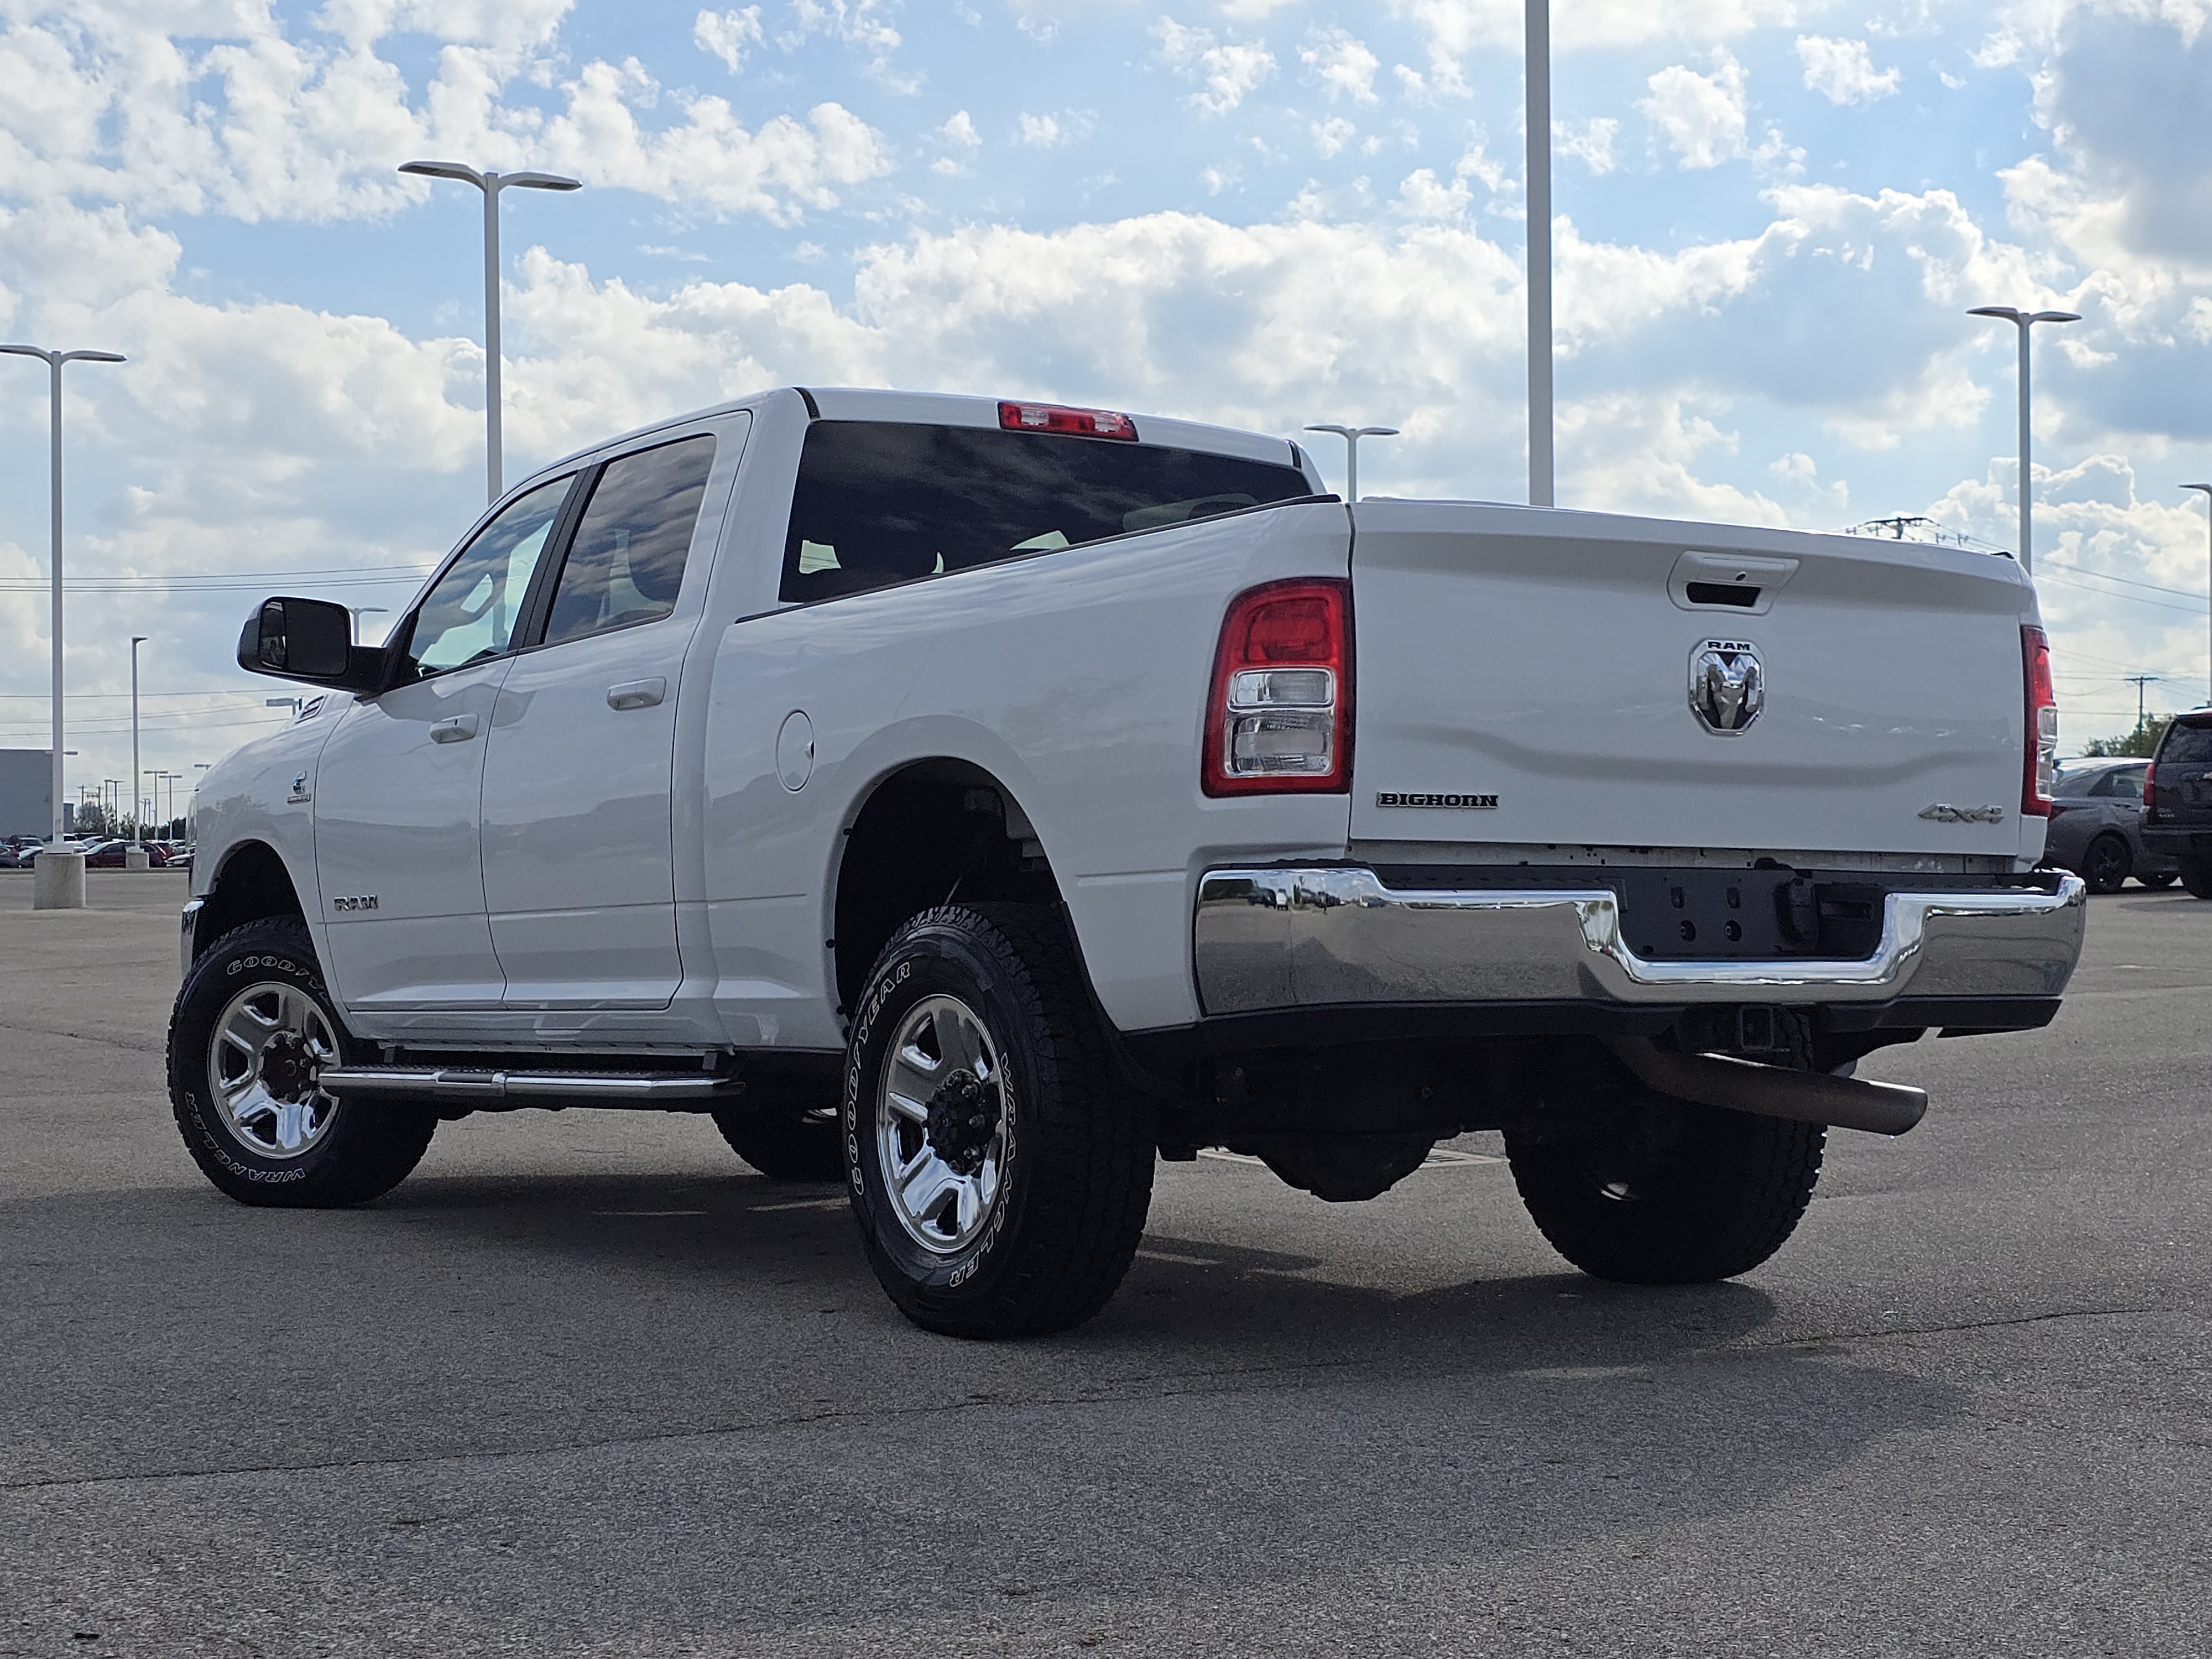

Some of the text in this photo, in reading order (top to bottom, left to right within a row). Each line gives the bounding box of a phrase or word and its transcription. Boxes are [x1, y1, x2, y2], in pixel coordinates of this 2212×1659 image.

[1707, 640, 1751, 651] RAM
[1379, 792, 1499, 808] BIGHORN
[333, 895, 378, 911] RAM
[848, 962, 911, 1196] GOODYEAR
[185, 1091, 305, 1183] WRANGLER
[950, 1052, 1016, 1287] WRANGLER
